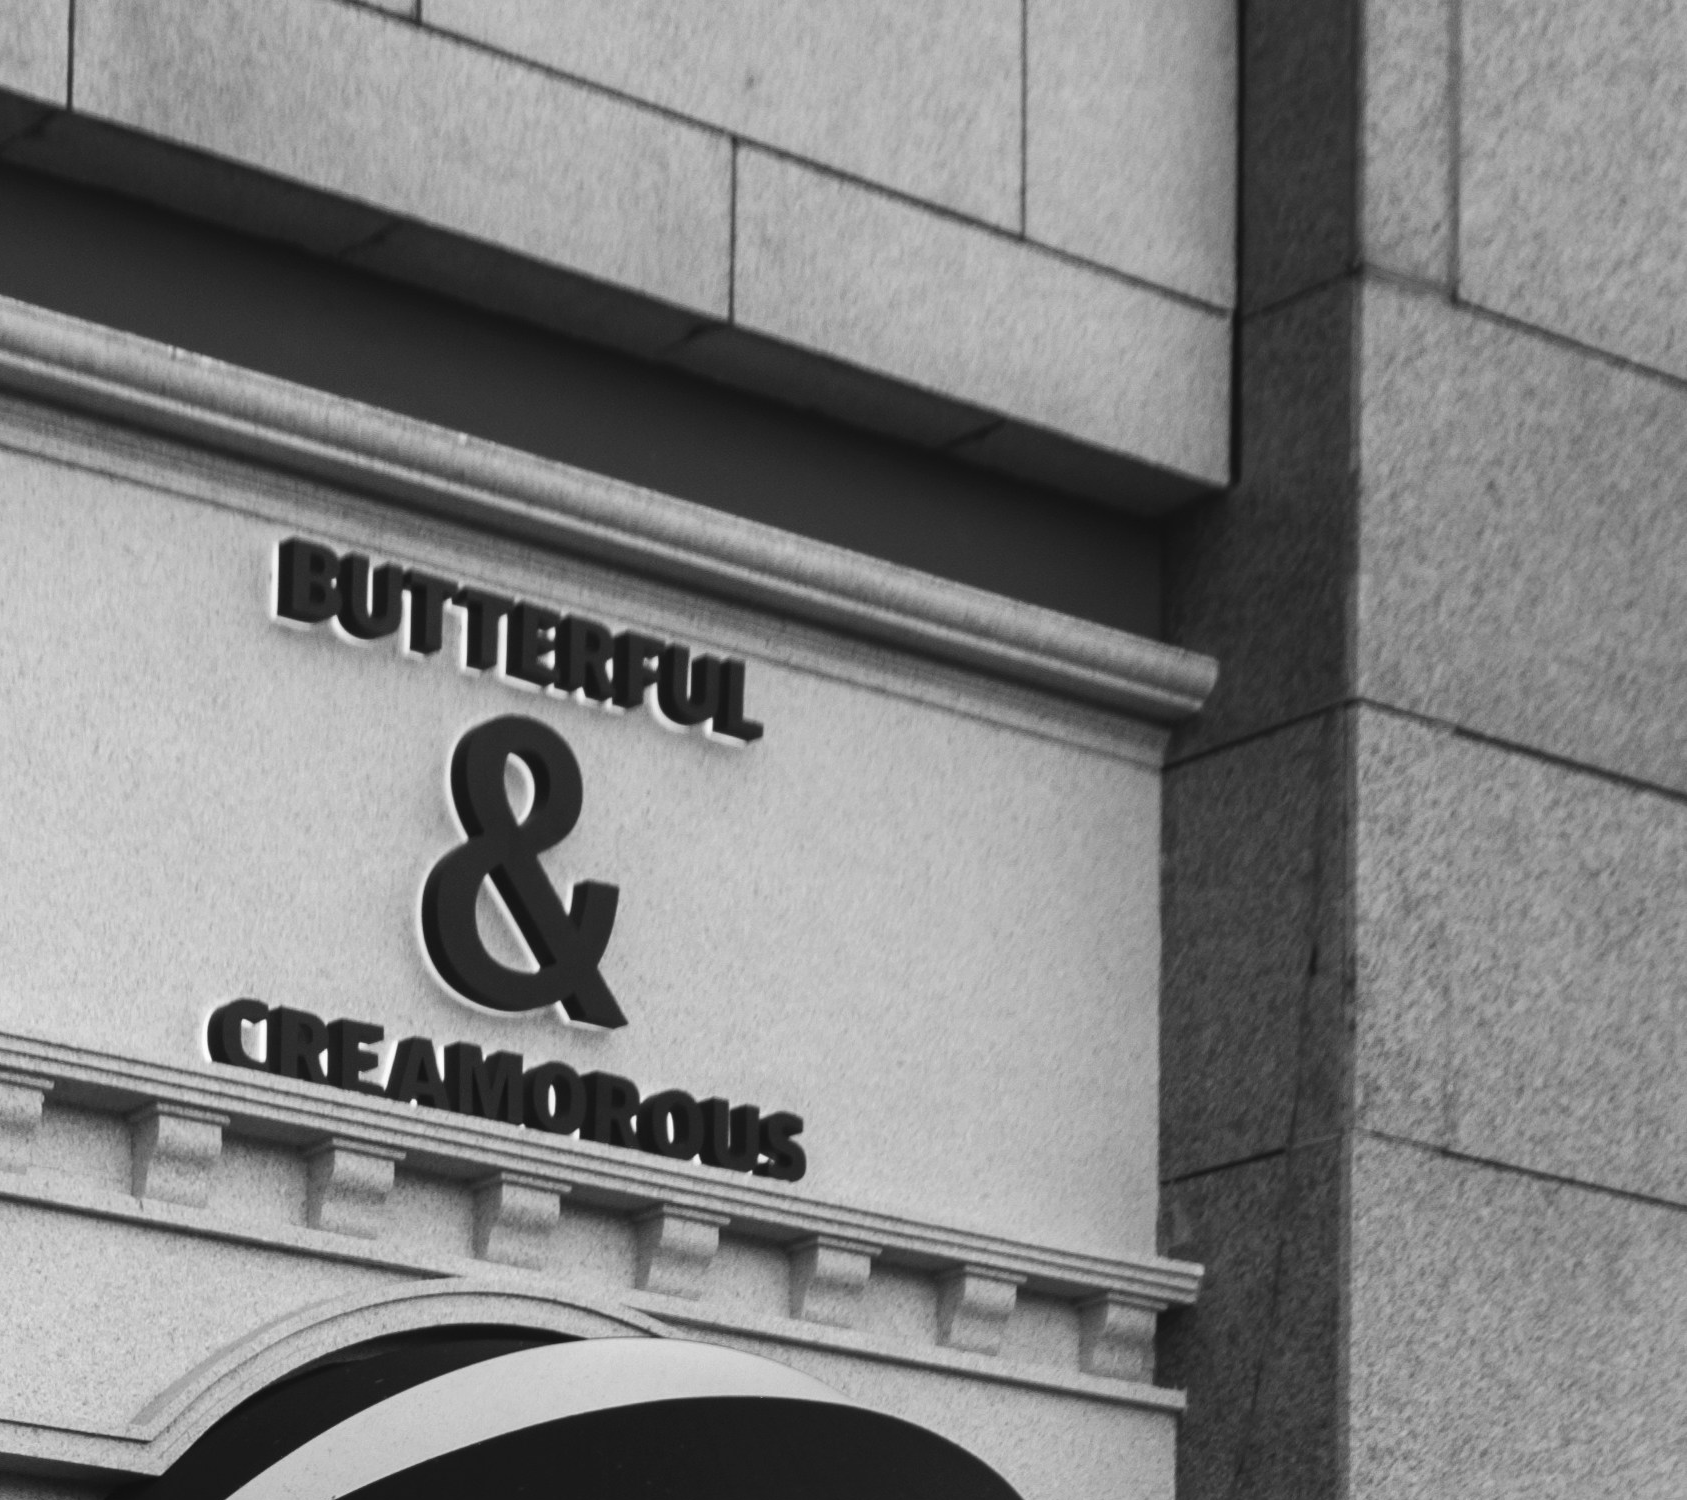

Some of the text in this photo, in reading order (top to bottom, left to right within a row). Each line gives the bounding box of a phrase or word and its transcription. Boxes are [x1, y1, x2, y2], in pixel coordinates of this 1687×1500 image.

[275, 537, 764, 744] BUTTERFUL
[421, 712, 629, 1030] &
[207, 998, 807, 1182] CREAMOROUS
